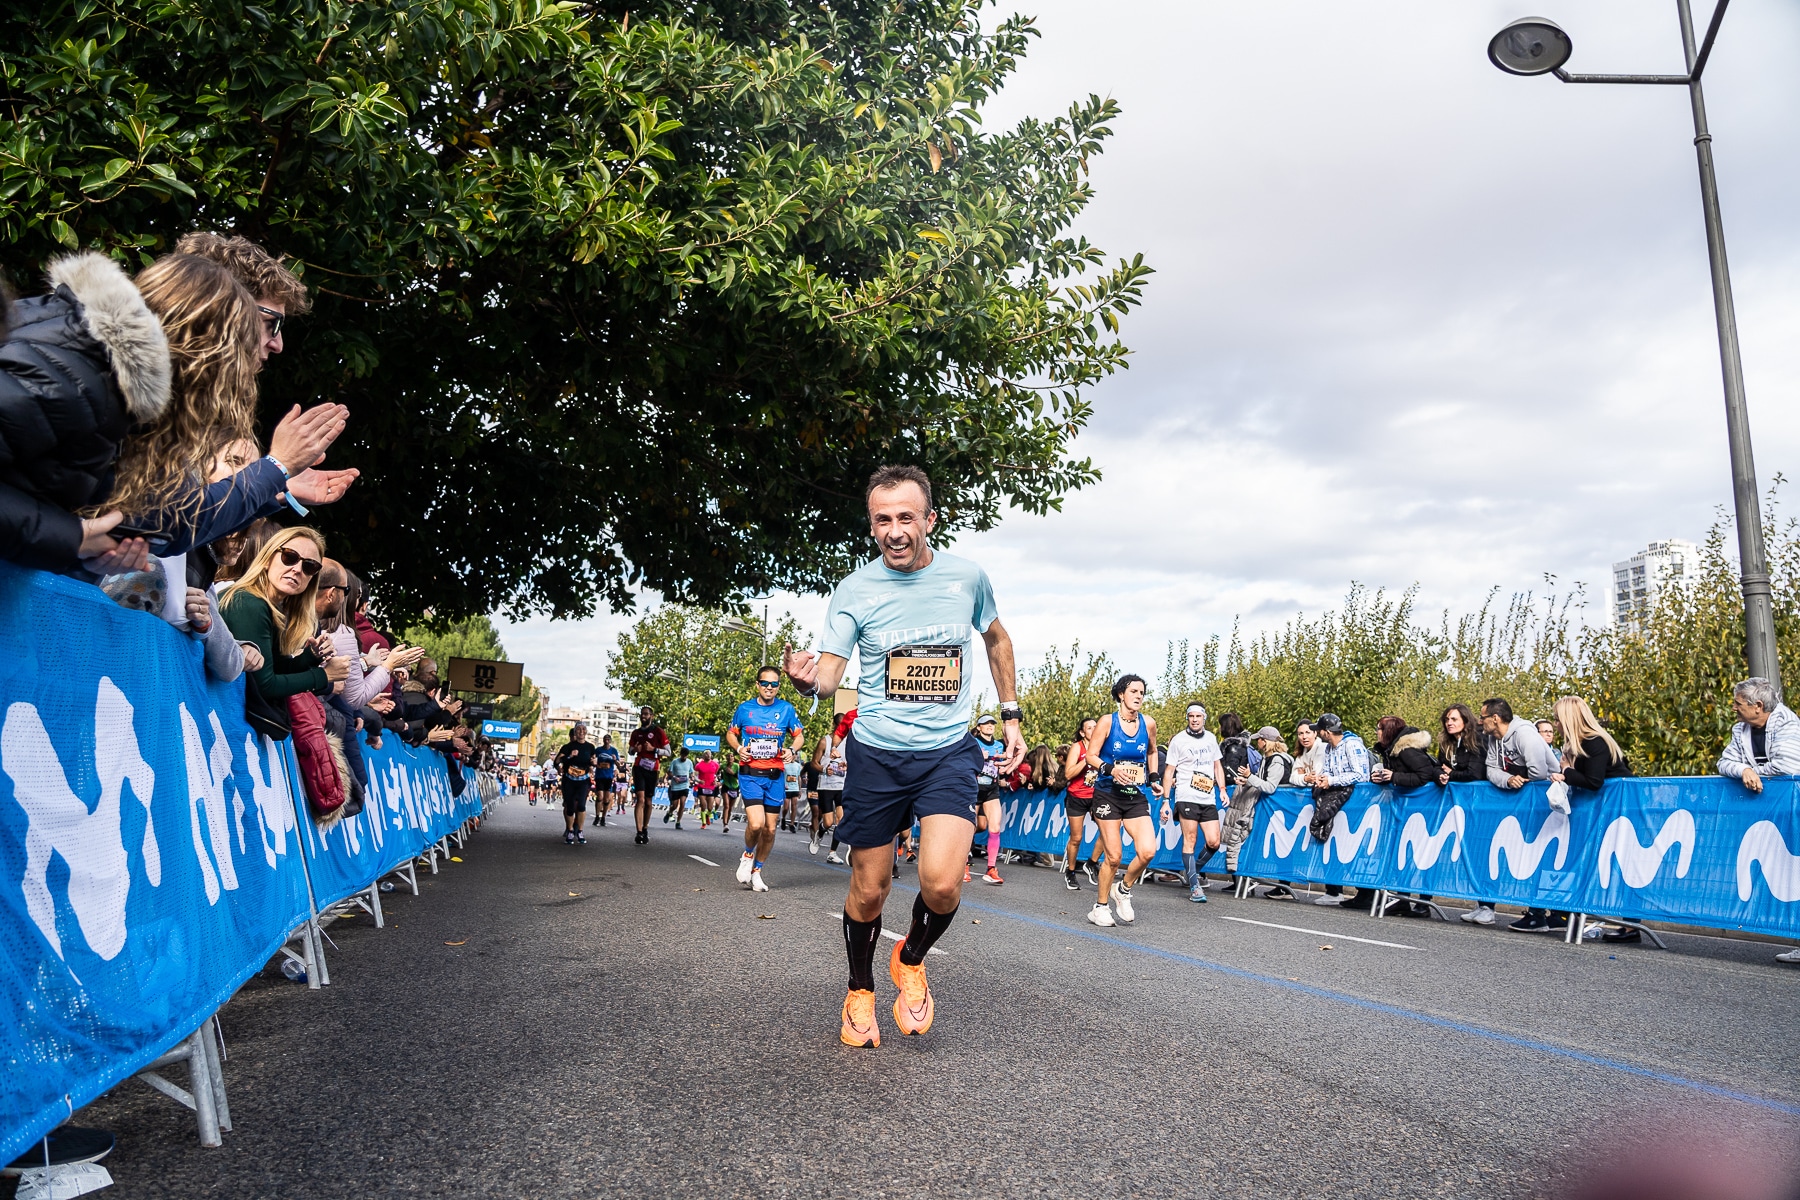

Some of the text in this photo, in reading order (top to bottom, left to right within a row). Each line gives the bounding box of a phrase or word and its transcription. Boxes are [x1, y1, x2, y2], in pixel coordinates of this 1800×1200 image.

[880, 625, 967, 647] VALENCIA
[907, 665, 946, 677] 22077
[890, 679, 959, 691] FRANCESCO
[494, 725, 518, 734] ZURICH
[695, 739, 717, 747] ZURICH
